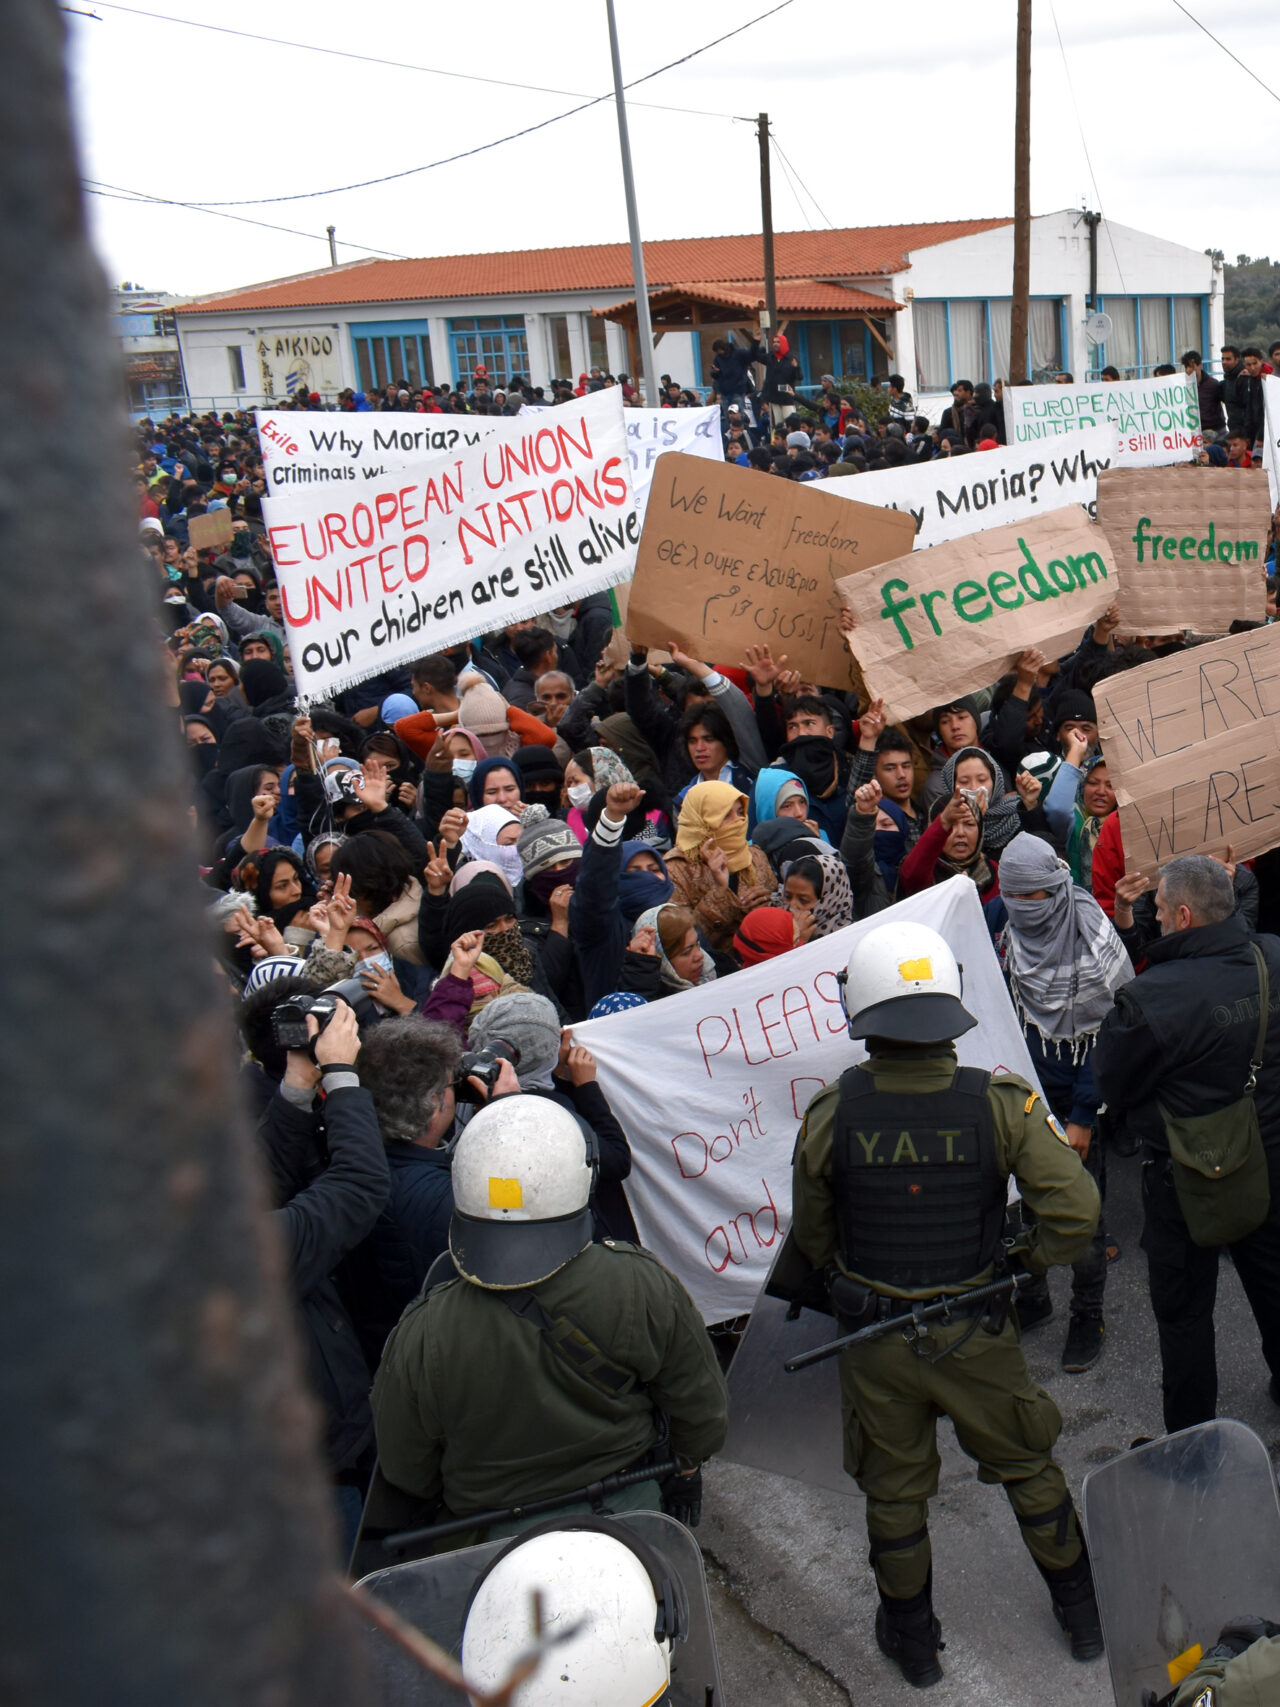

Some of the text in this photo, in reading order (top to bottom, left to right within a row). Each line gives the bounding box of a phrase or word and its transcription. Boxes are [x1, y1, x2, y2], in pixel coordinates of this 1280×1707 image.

[276, 336, 332, 357] AIKIDO
[653, 417, 678, 447] is
[1022, 381, 1198, 418] EUROPEAN UNION
[260, 419, 299, 456] Exile
[309, 429, 363, 458] Why
[373, 427, 459, 454] Moria?
[1129, 432, 1157, 452] still
[1162, 430, 1203, 451] alive
[269, 416, 594, 566] EUROPEAN UNION
[670, 475, 708, 514] We
[717, 492, 768, 530] Want
[936, 462, 1045, 519] Moria?
[281, 456, 628, 628] UNITED NATIONS
[1132, 516, 1259, 563] freedom
[301, 511, 641, 673] our chidren are still alive
[880, 536, 1109, 651] freedom
[1105, 670, 1193, 764] WE
[1133, 779, 1197, 862] WE
[1203, 754, 1276, 843] ARE
[695, 970, 848, 1079] PLEAS
[671, 1085, 768, 1179] Don't
[704, 1177, 785, 1273] and
